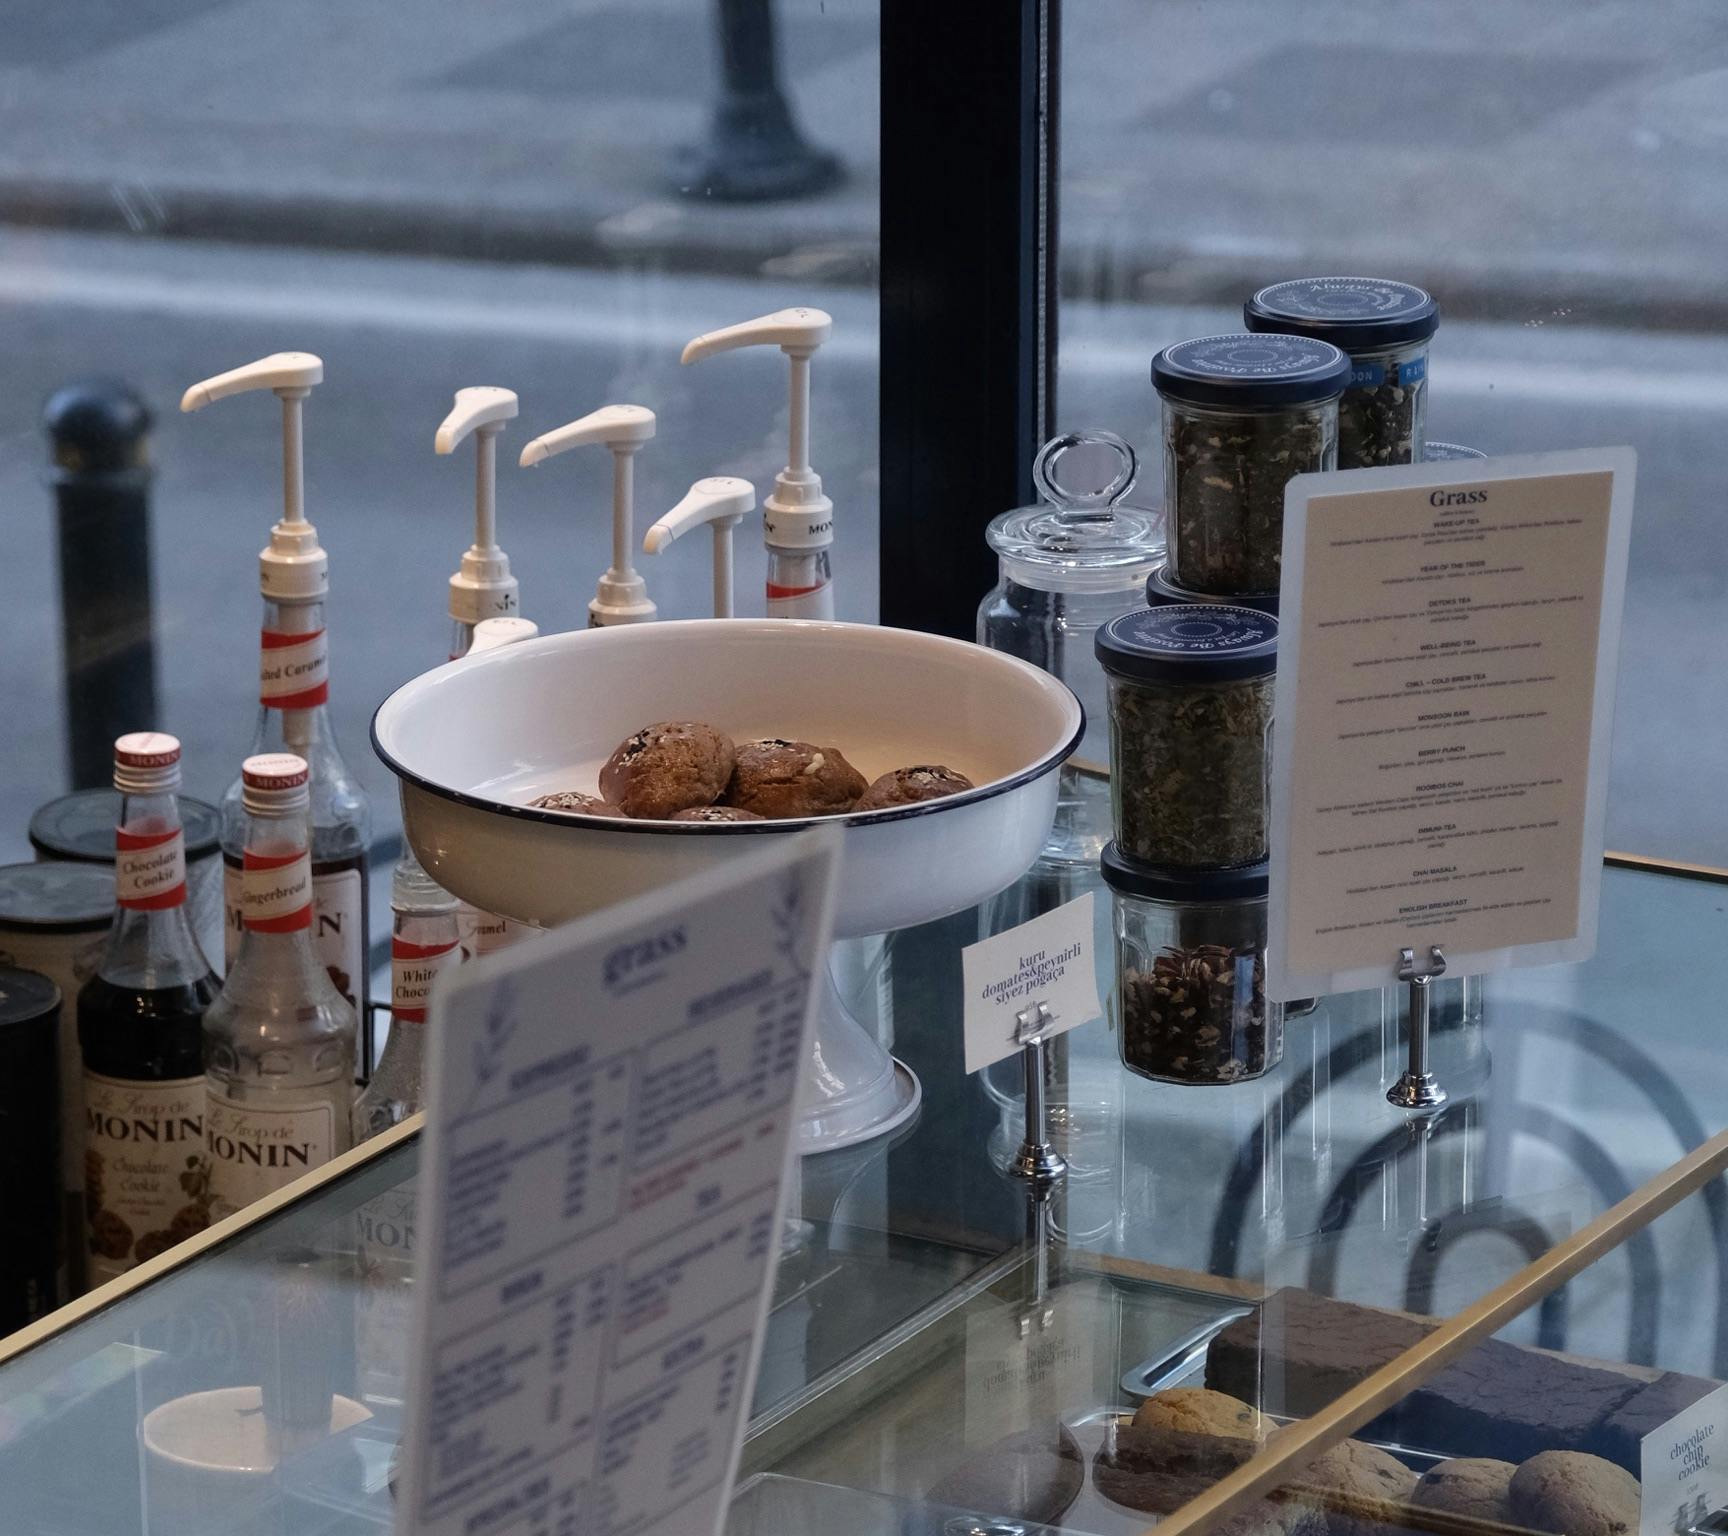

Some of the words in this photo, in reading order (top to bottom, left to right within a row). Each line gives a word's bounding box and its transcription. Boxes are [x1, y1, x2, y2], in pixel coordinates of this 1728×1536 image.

[1429, 489, 1488, 508] Grass
[123, 850, 177, 874] Chocolate
[134, 868, 175, 890] Cookie
[981, 942, 1081, 1000] domates&peynirli
[1019, 950, 1045, 970] kuru
[1670, 1424, 1714, 1460] chocolate
[1678, 1455, 1710, 1481] cookie
